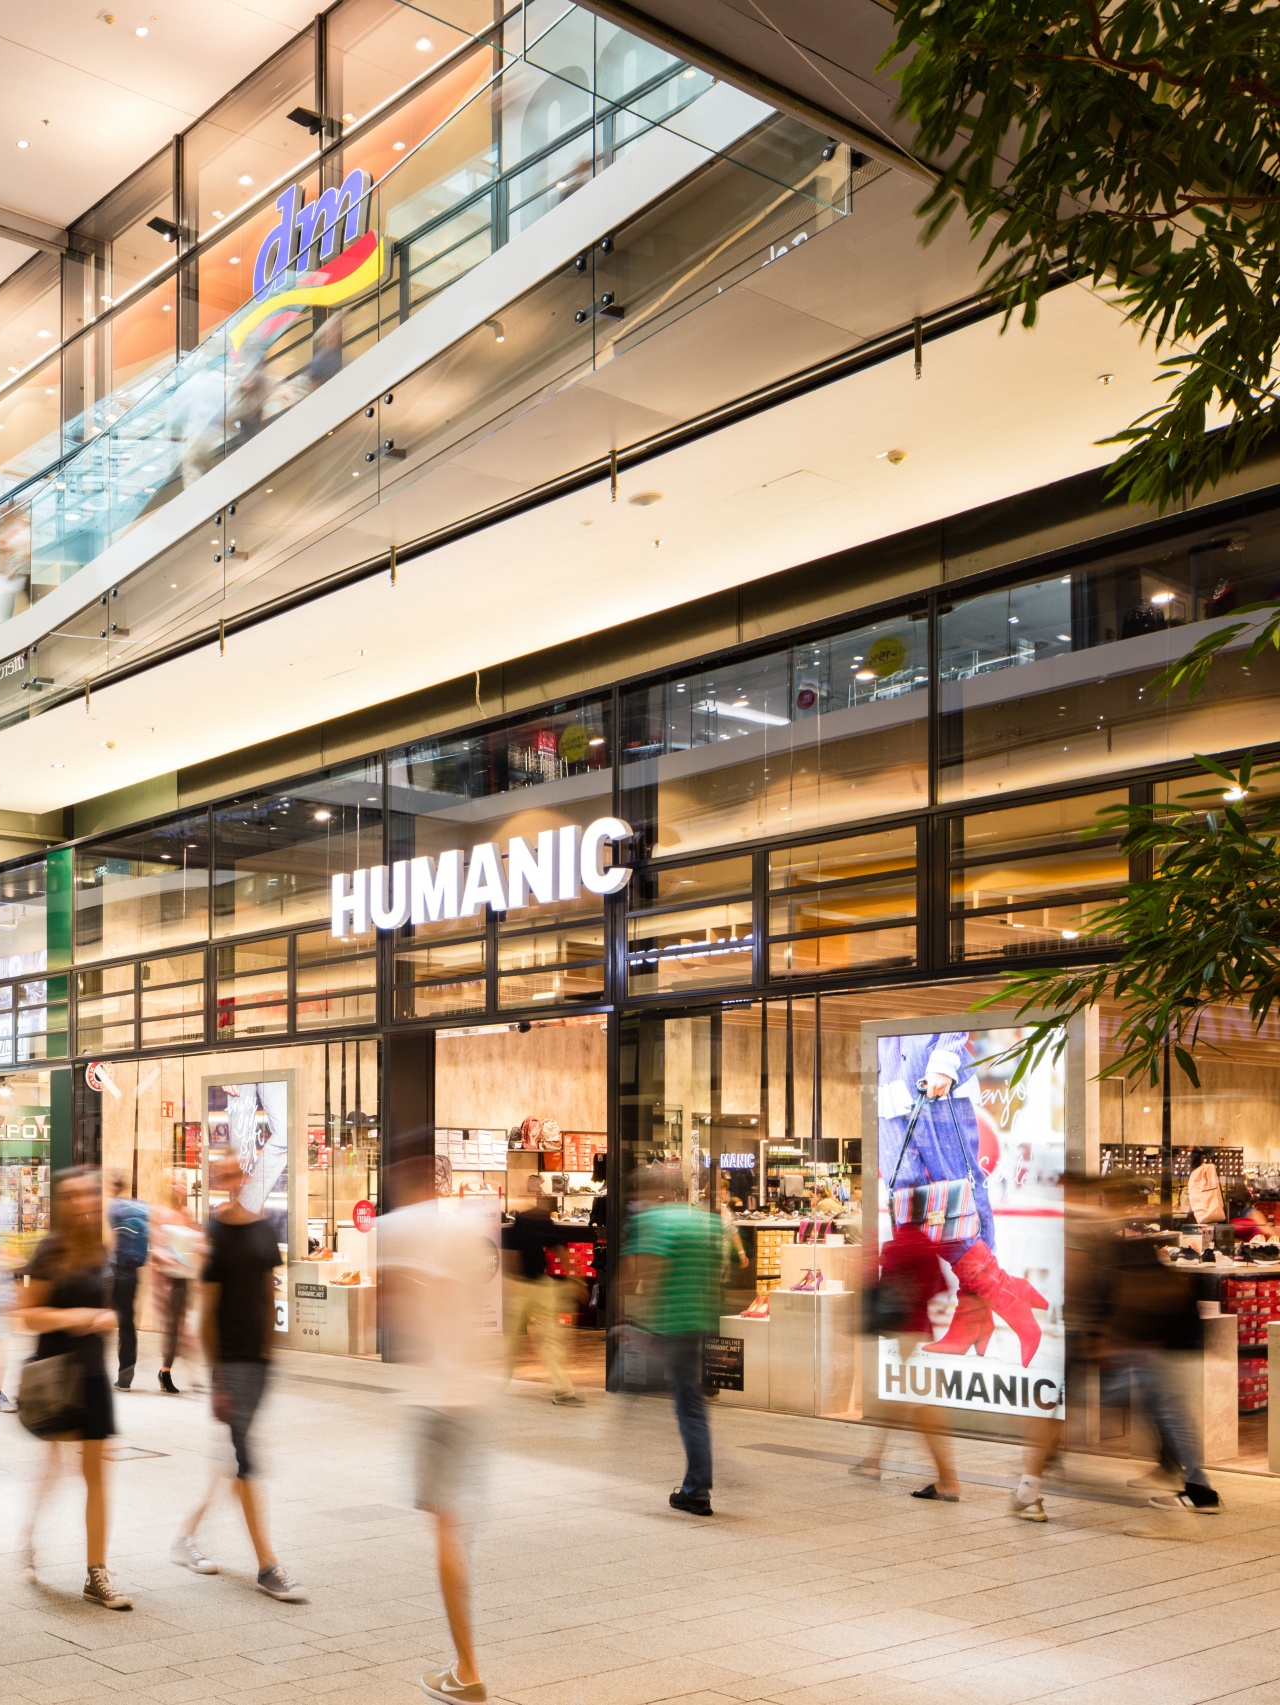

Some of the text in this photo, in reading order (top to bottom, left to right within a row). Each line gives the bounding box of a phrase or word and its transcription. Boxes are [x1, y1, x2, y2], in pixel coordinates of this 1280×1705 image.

[253, 168, 370, 304] dm
[331, 817, 634, 938] HUMANIC
[720, 1339, 741, 1347] ONLINE
[885, 1363, 1057, 1411] HUMANIC
